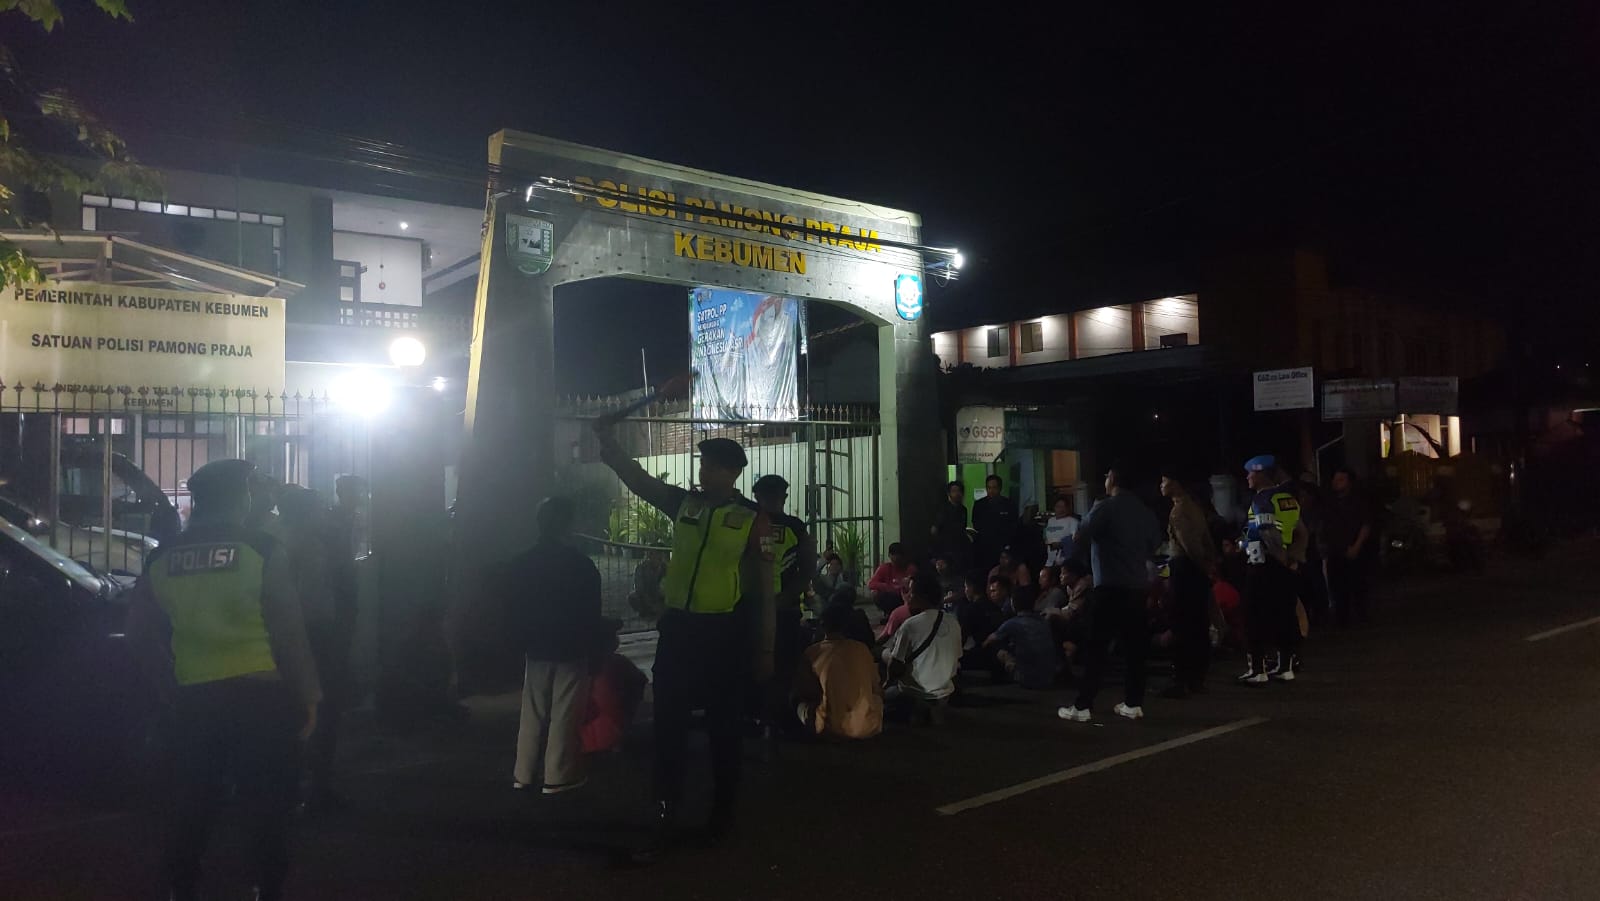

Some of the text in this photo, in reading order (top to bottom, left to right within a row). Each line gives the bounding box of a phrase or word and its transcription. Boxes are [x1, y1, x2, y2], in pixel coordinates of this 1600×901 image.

[574, 175, 881, 253] POLISI PAMONG PRAJA
[672, 229, 807, 275] KEBUMEN
[14, 287, 269, 318] PEMERINTAH KABUPATEN KEBUMEN
[719, 303, 727, 316] PP
[31, 333, 253, 358] SATUAN POLISI PAMONG PRAJA
[972, 425, 1003, 440] GGSP
[169, 548, 235, 573] POLISI
